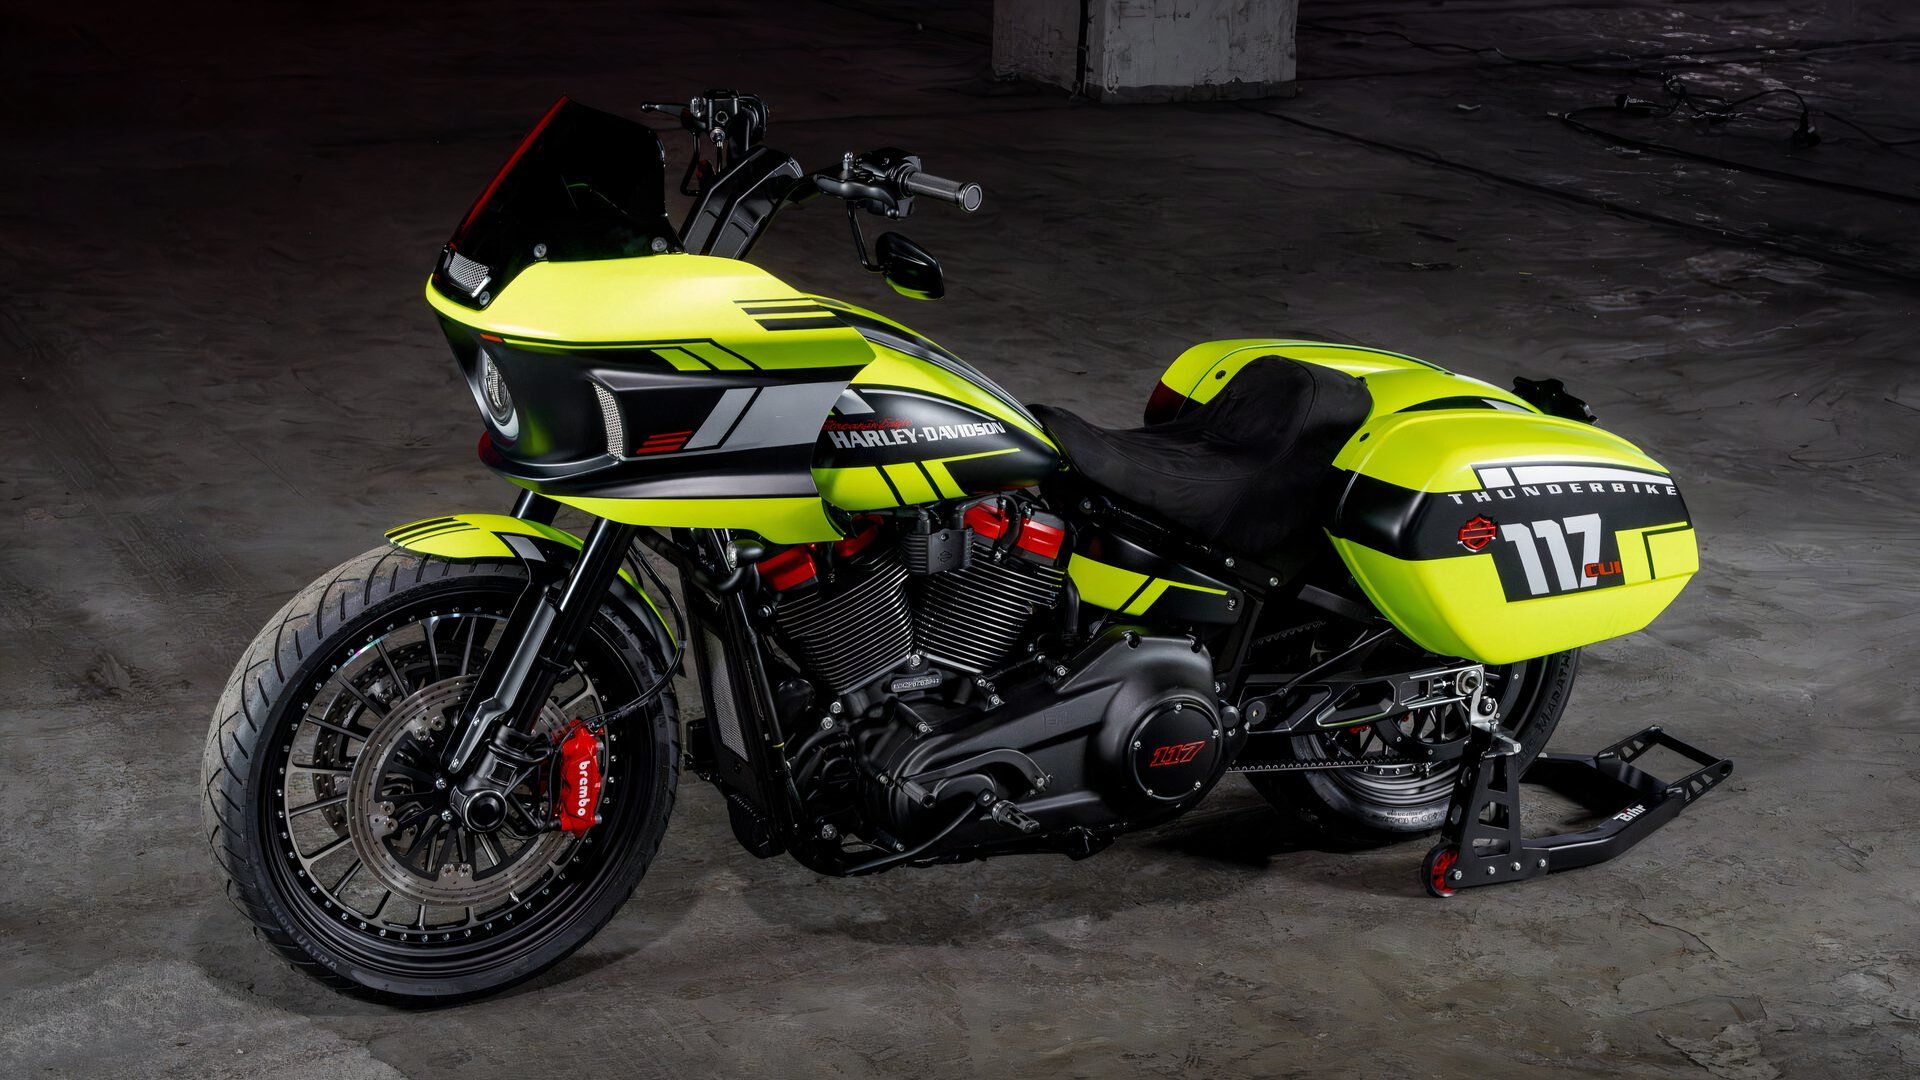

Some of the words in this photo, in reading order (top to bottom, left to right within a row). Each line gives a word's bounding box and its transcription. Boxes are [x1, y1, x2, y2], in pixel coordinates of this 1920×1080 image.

[828, 421, 1006, 449] HARLEY-DAVIDSON
[1448, 482, 1678, 504] THUNDERBIKE
[1500, 513, 1601, 595] 117
[1584, 560, 1622, 578] CUI
[1149, 740, 1206, 768] 117
[578, 760, 591, 816] brembo
